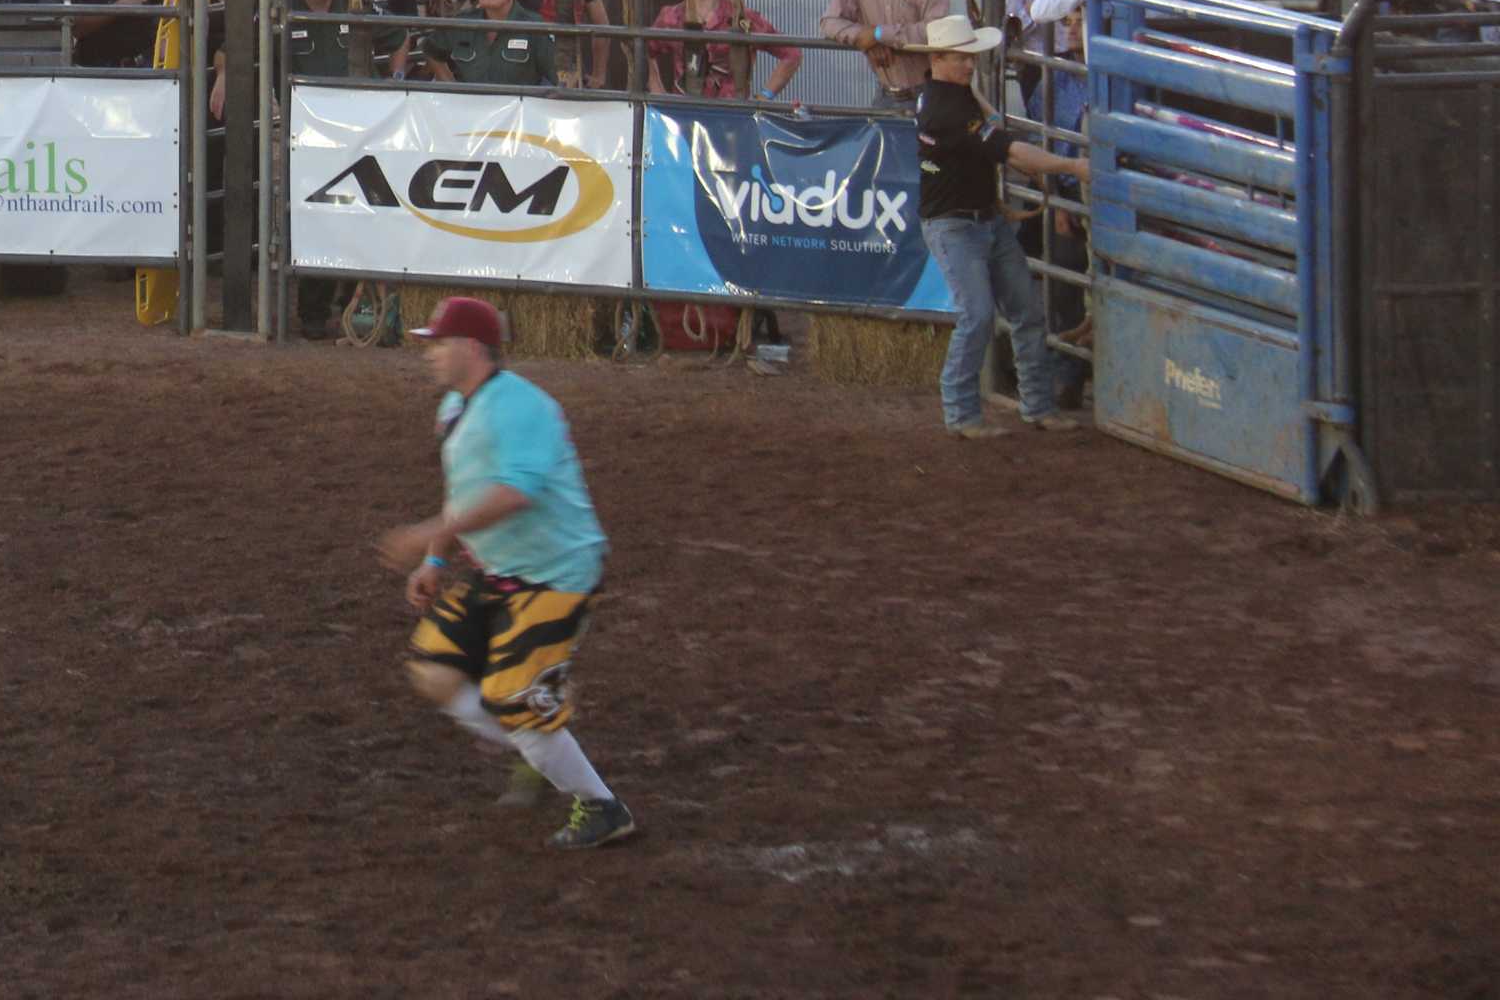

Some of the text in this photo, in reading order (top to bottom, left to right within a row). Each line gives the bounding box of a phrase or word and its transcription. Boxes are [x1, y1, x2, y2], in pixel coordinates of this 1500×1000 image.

[304, 154, 571, 216] AEM
[715, 165, 908, 232] viadux
[731, 232, 898, 255] WATER NETWORK SOLUTIONS
